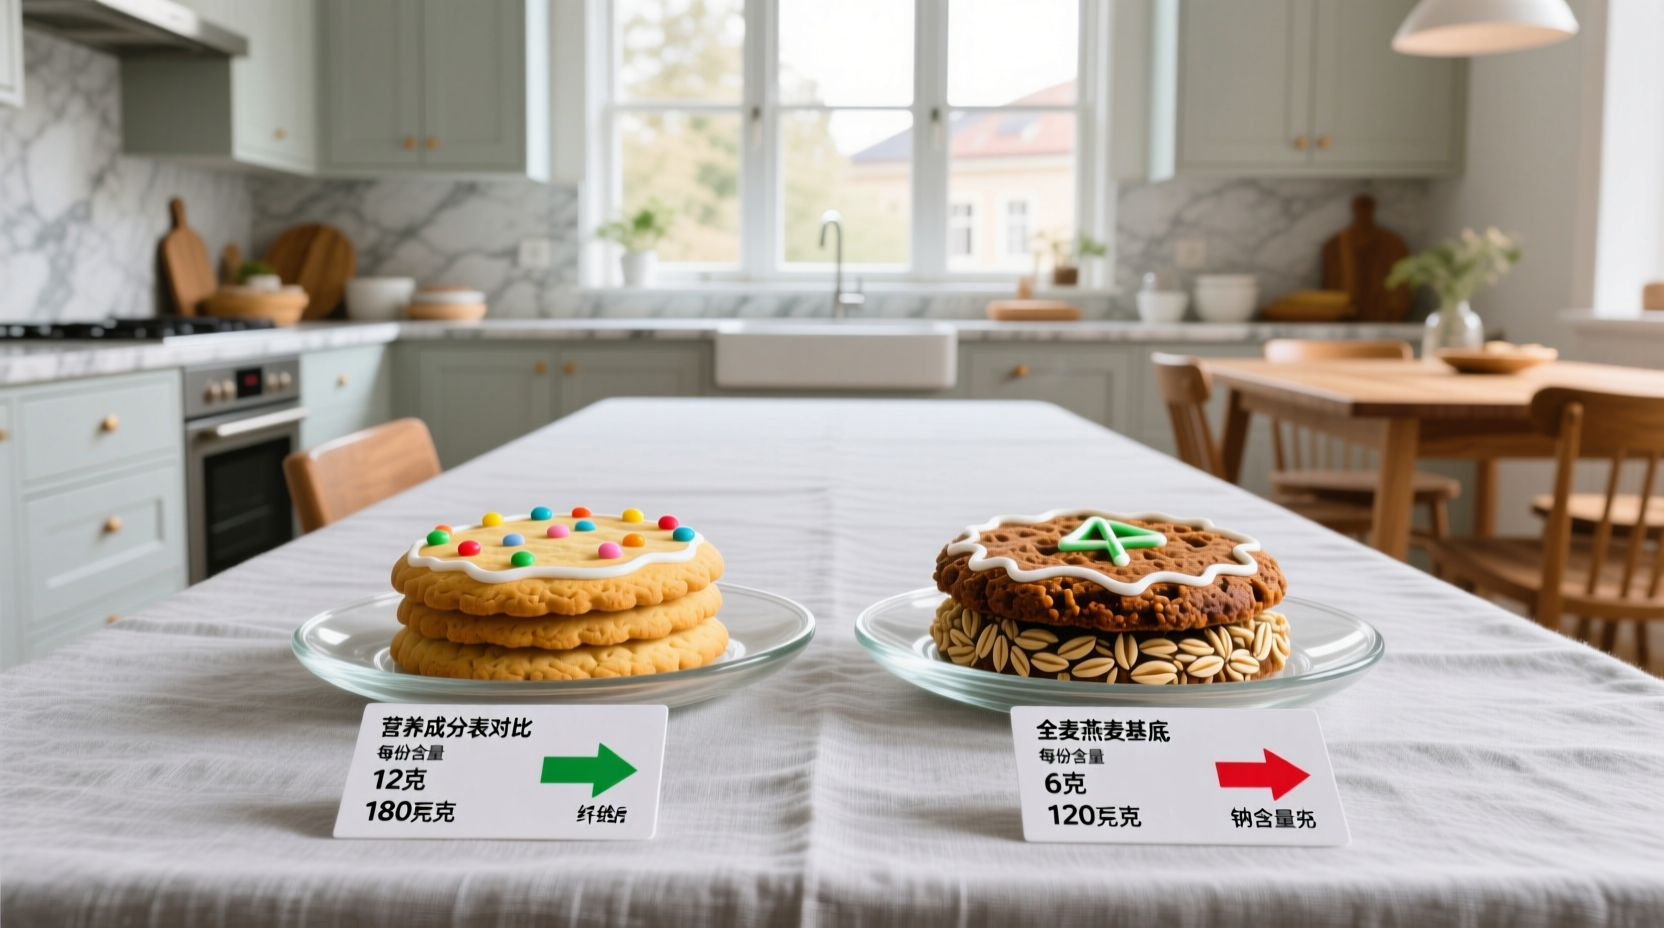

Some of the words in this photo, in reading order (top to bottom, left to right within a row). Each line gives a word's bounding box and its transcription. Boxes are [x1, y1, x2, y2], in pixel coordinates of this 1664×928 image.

[381, 716, 533, 739] 营养成分表对比
[1036, 719, 1171, 742] 全麦燕麦基底
[377, 744, 444, 762] 每份含量
[1038, 748, 1105, 765] 每份含量
[373, 768, 428, 791] 12克
[1044, 771, 1087, 795] 6克
